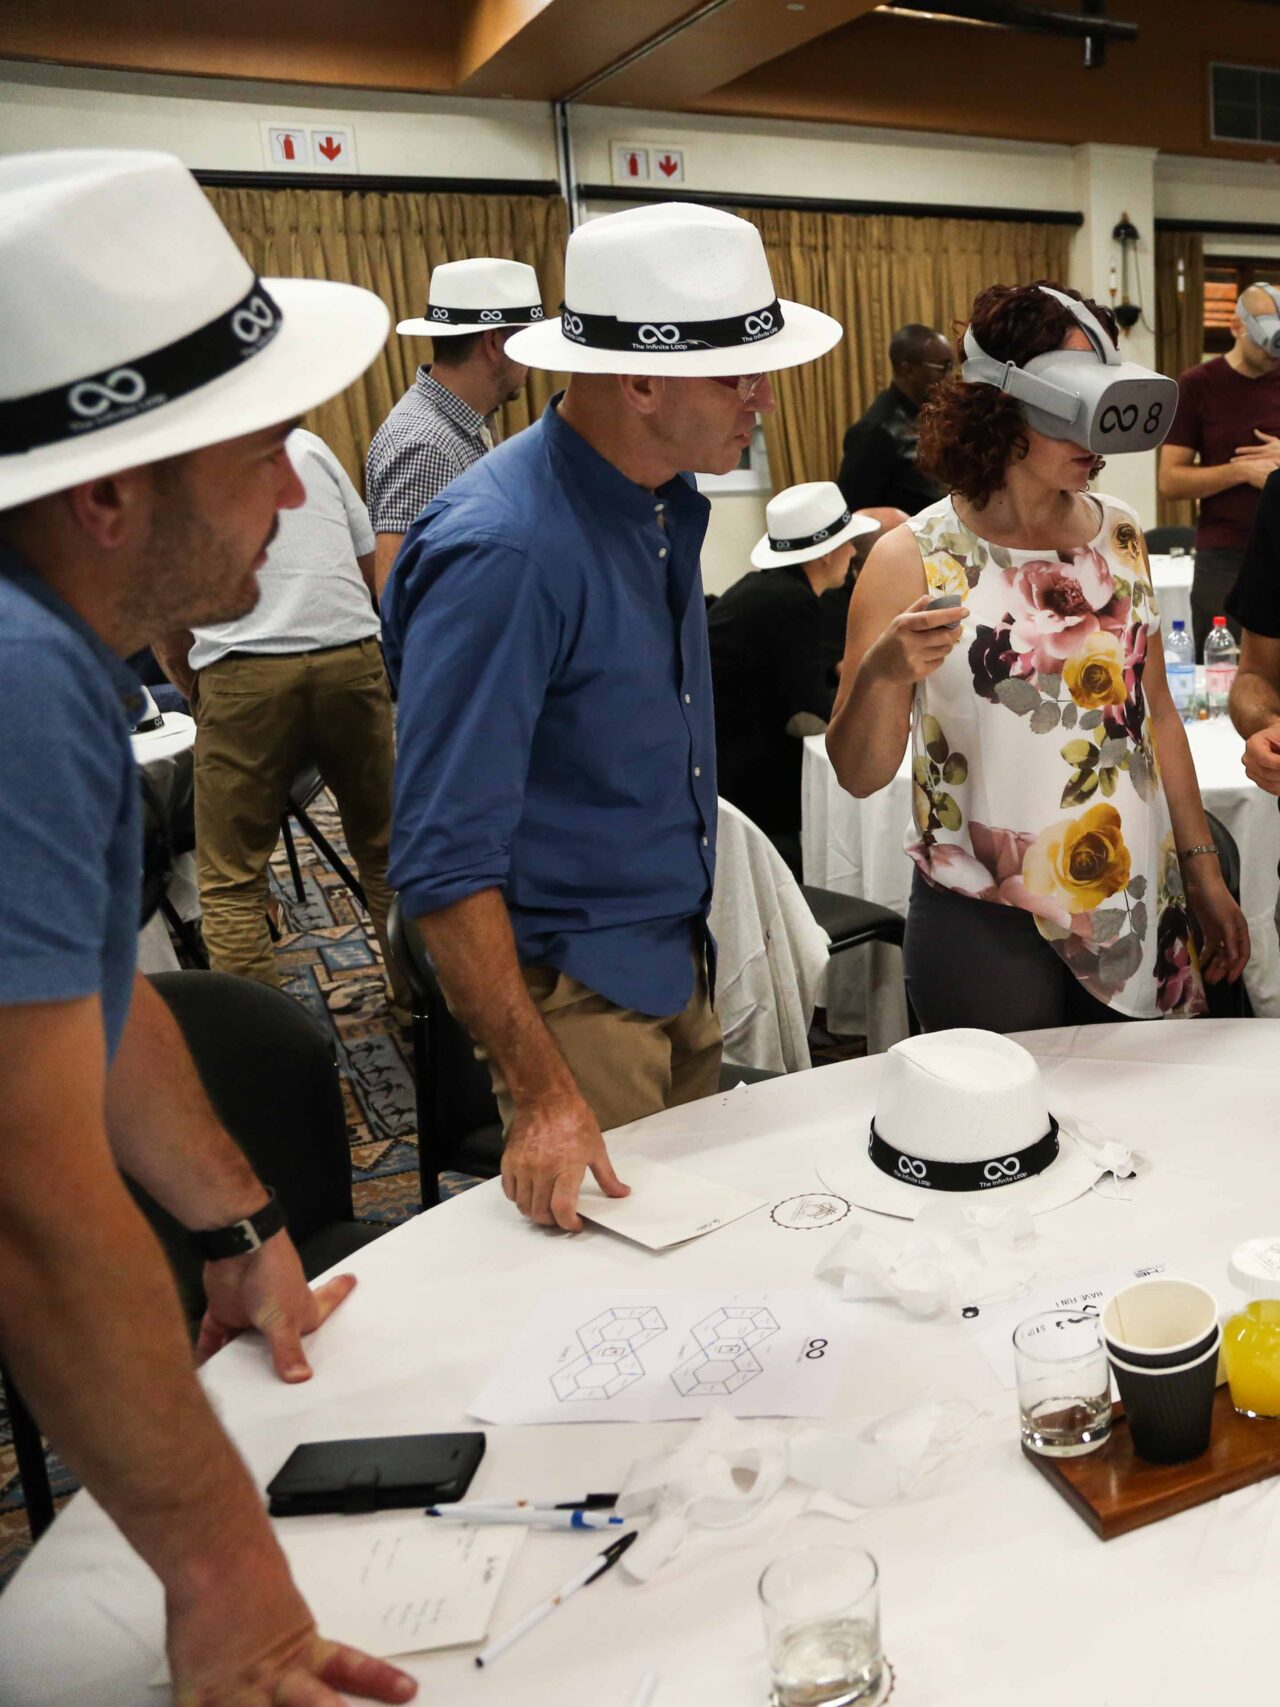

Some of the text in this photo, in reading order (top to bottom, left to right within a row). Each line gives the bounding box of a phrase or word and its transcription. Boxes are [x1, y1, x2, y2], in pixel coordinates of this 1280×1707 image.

[631, 342, 645, 350] The
[1143, 402, 1163, 434] 8
[992, 1177, 1013, 1186] Infinite
[1014, 1171, 1028, 1180] Loop
[1082, 1290, 1103, 1302] HAVE
